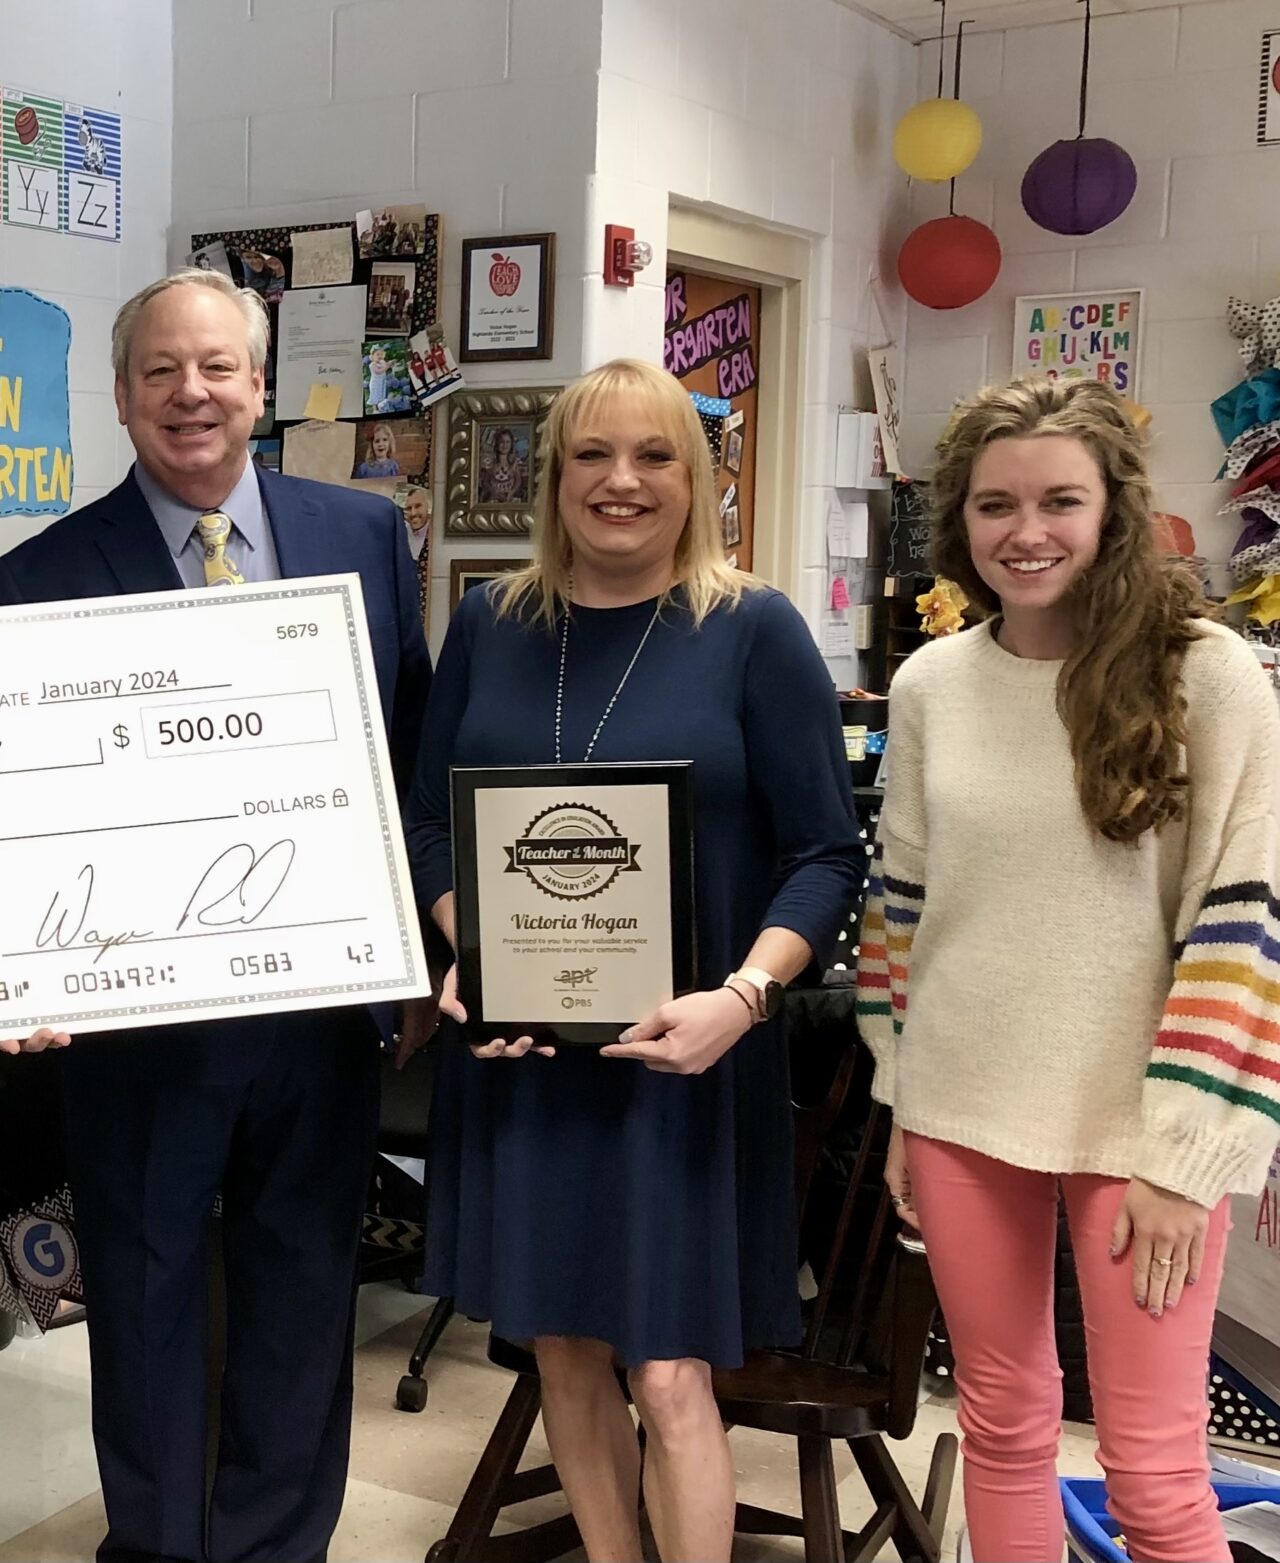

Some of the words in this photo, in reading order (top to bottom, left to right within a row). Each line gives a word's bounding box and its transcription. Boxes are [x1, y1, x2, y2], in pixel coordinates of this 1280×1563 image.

[17, 165, 49, 224] Yy
[77, 180, 108, 229] Zz
[276, 622, 319, 641] 5679
[39, 678, 123, 700] January
[128, 669, 180, 691] 2024
[111, 723, 131, 750] $
[158, 711, 264, 746] 500.00
[243, 793, 327, 817] DOLLARS
[517, 846, 571, 860] Teacher
[583, 845, 626, 860] Month
[541, 875, 580, 891] JANUARY
[582, 873, 601, 889] 2024
[510, 913, 577, 930] Victoria
[581, 912, 639, 935] Hogan
[502, 937, 537, 945] Presented
[539, 946, 563, 954] school
[563, 946, 578, 954] and
[229, 951, 293, 977] 0583
[346, 943, 375, 964] 42
[559, 967, 594, 988] apt
[575, 998, 593, 1008] PBS
